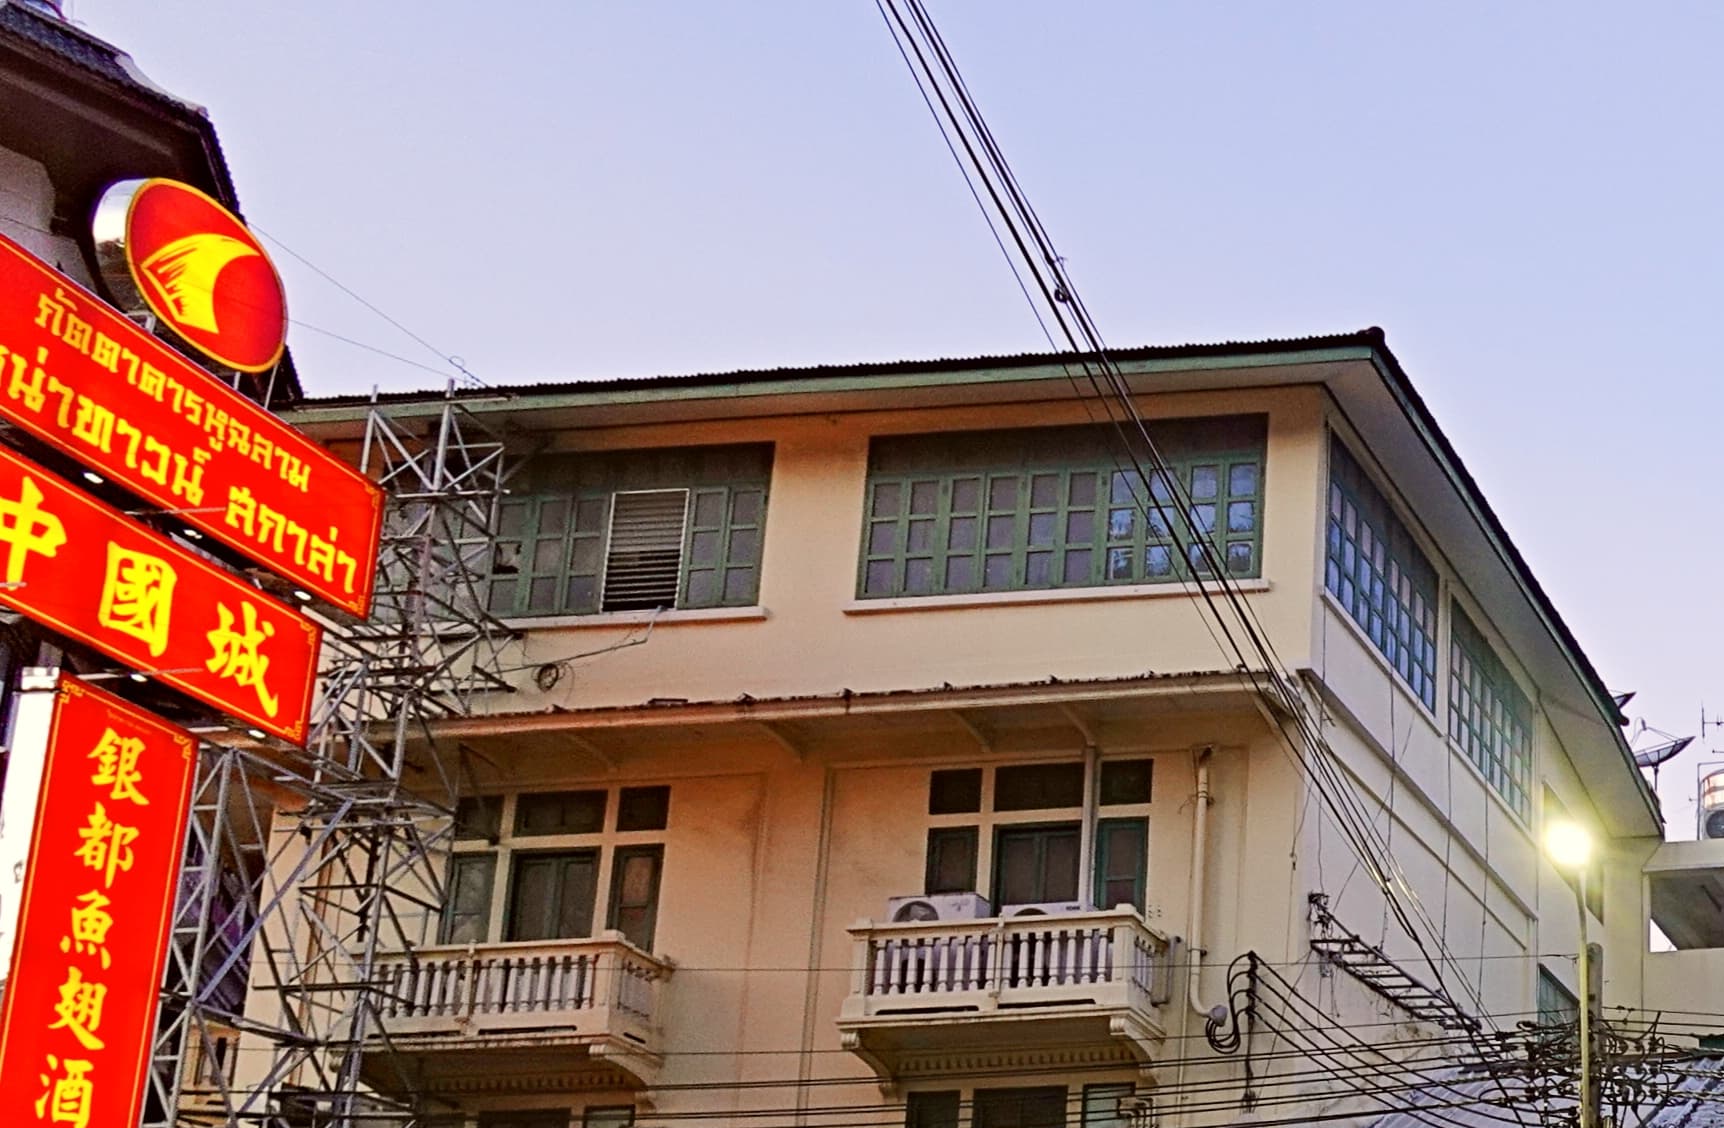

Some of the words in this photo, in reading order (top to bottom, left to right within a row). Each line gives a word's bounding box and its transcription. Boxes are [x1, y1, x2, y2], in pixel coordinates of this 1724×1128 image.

[0, 344, 212, 507] น่าทาวน์
[0, 476, 279, 718] 中國城
